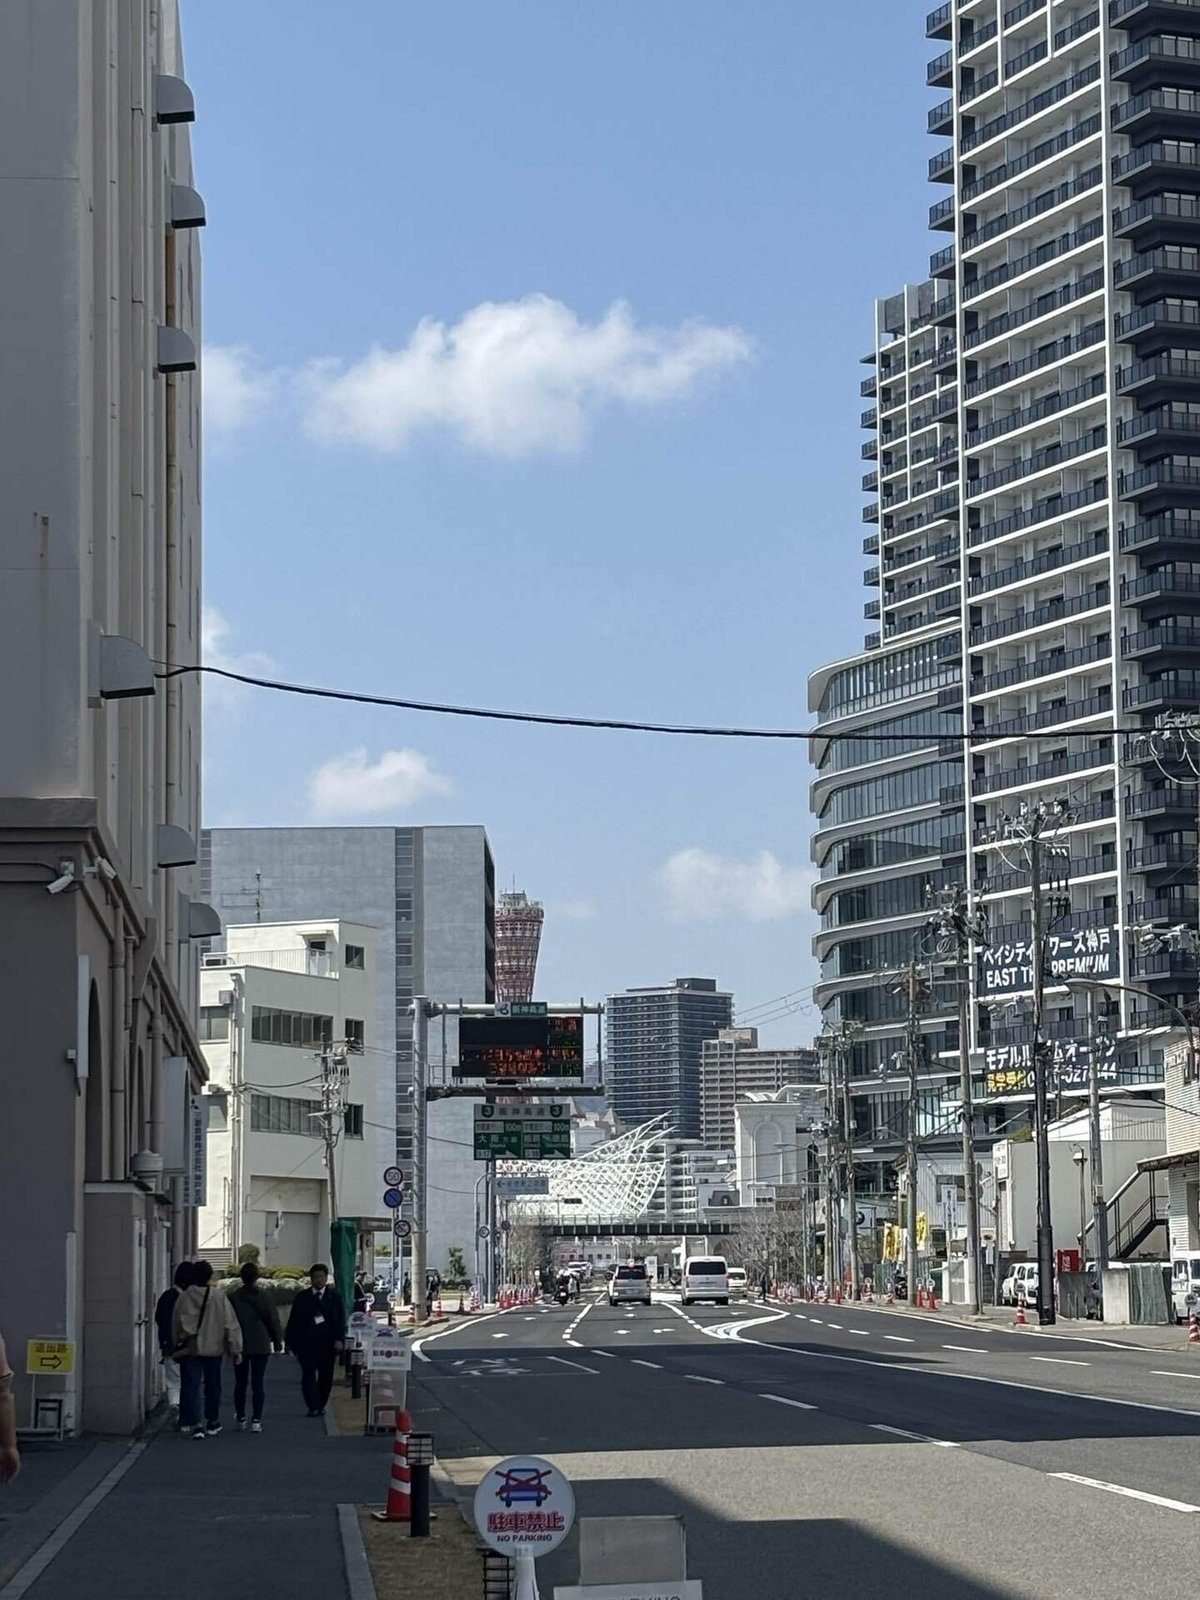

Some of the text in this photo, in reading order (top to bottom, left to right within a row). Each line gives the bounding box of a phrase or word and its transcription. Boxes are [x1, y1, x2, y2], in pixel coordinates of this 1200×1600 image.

[986, 967, 1017, 988] EAST
[388, 1171, 400, 1182] 50
[487, 1511, 565, 1533] 駐車禁止
[497, 1534, 552, 1543] NO PARKING
